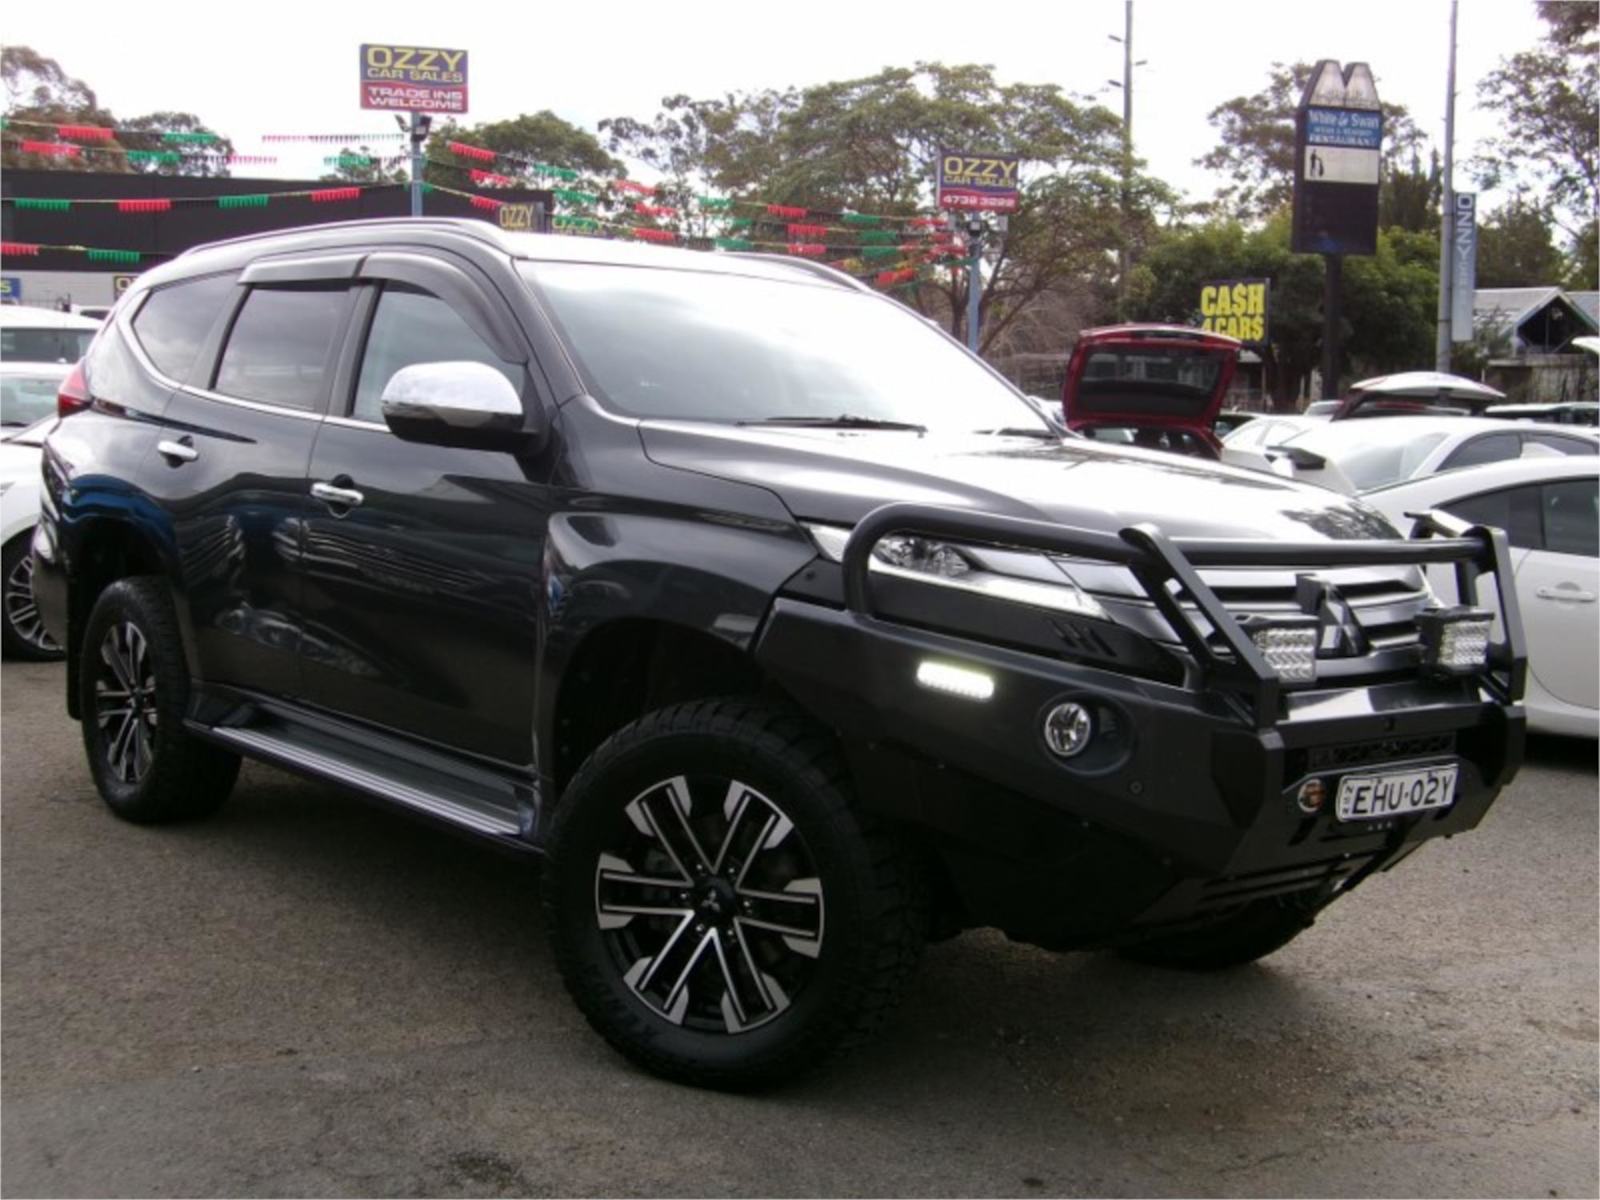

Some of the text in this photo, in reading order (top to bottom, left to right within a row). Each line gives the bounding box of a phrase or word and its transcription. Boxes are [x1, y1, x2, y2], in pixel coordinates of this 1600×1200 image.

[367, 47, 464, 71] OZZY
[368, 68, 463, 82] CAR SALES
[368, 87, 463, 100] TRADE INS
[368, 97, 463, 109] WELCOME
[944, 156, 1016, 177] OZZY
[499, 204, 534, 228] OZZY
